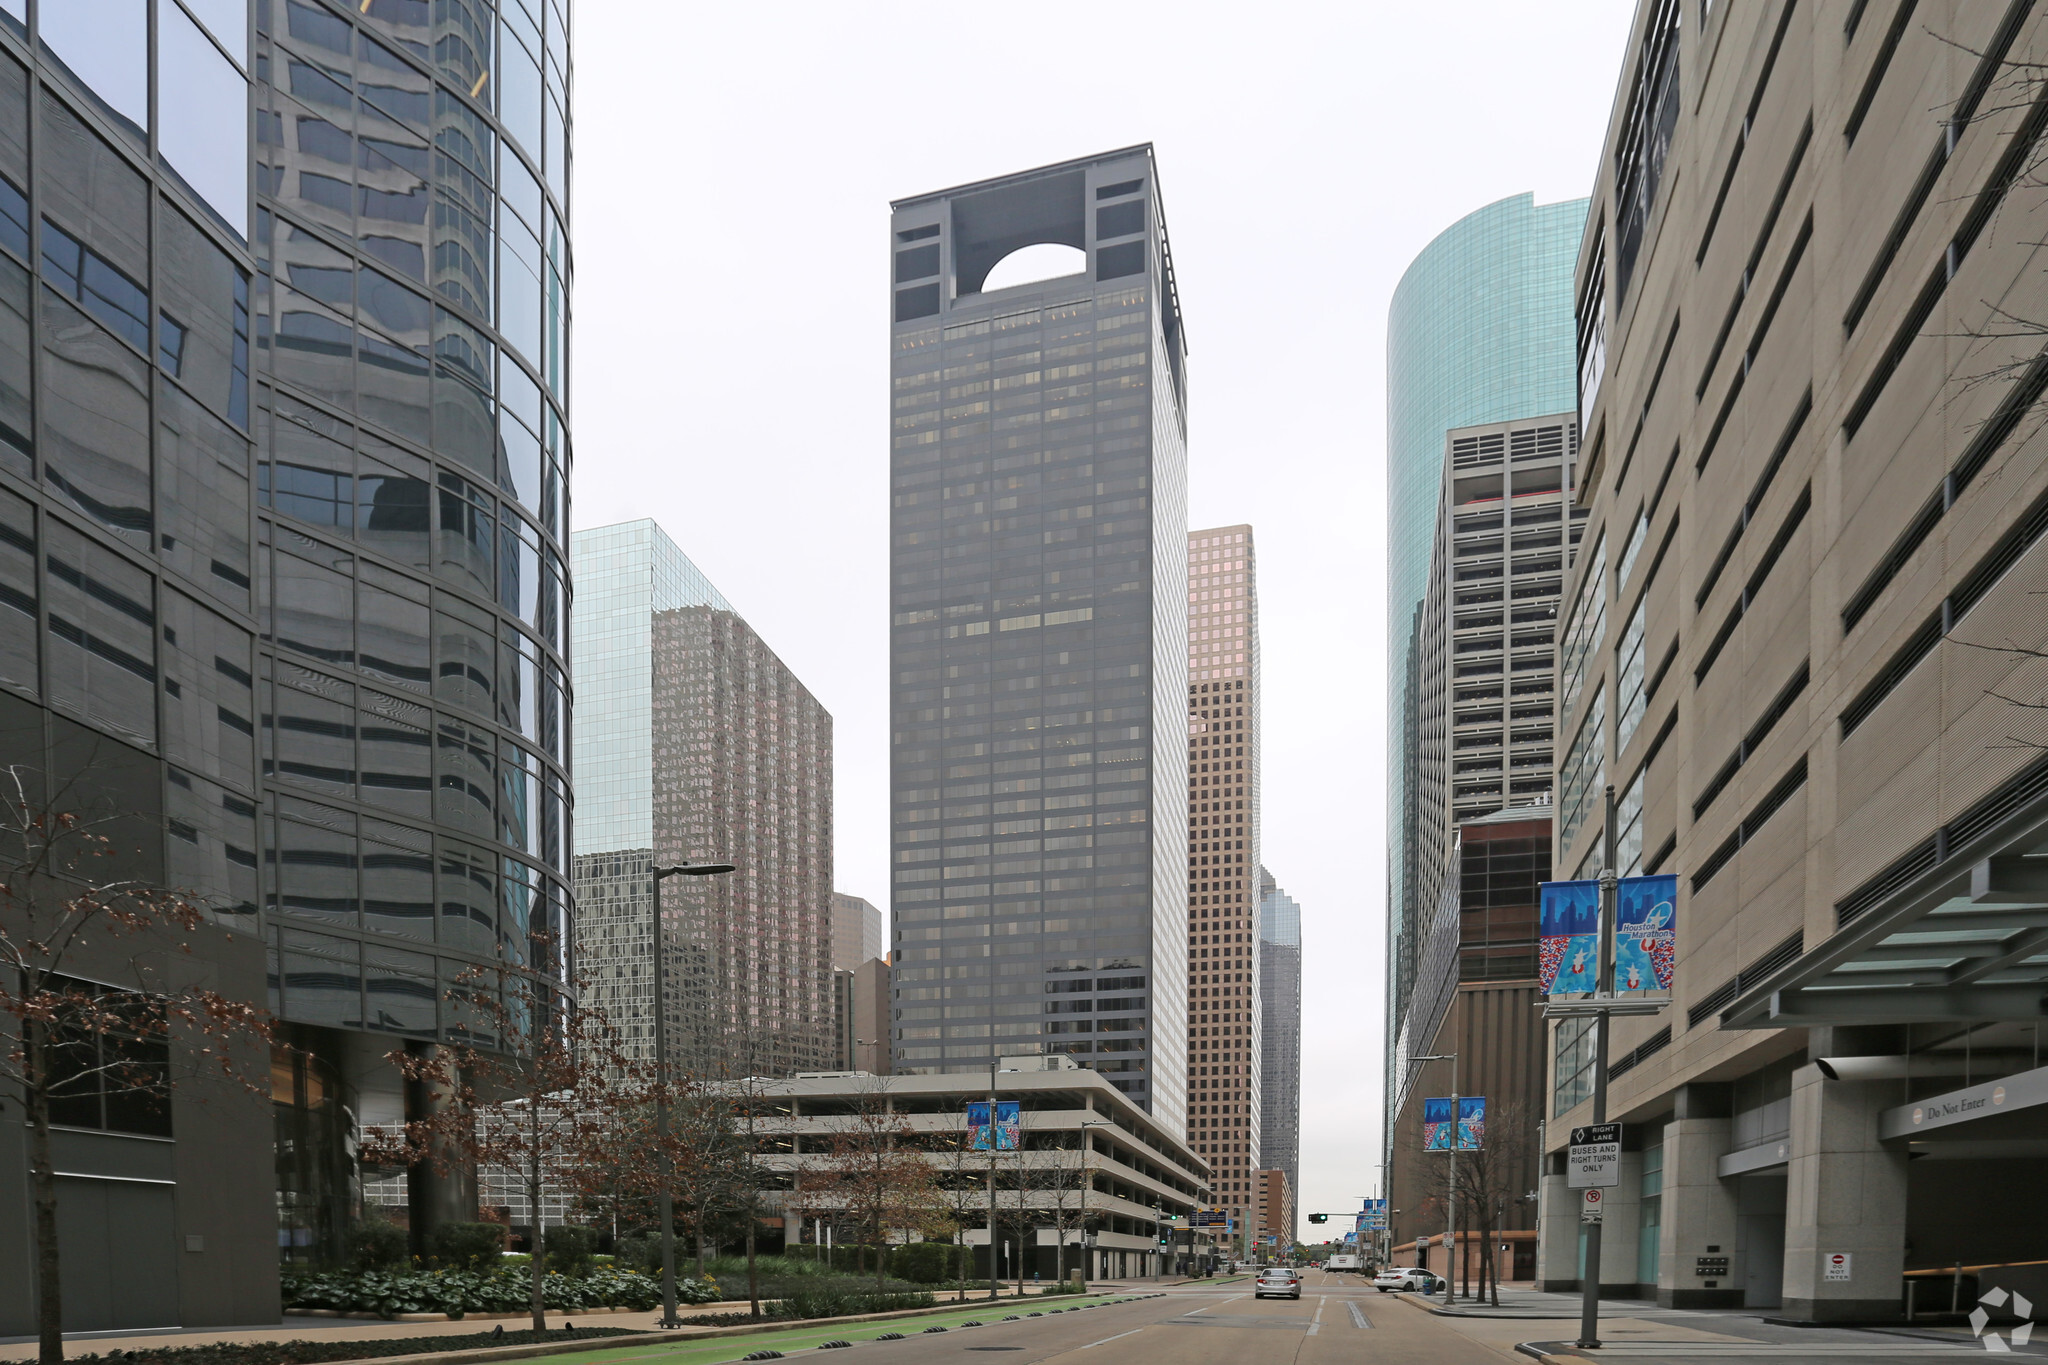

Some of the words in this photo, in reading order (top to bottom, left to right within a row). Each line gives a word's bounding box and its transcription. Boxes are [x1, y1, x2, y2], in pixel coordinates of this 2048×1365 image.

[1623, 924, 1655, 932] Houston
[1632, 931, 1668, 939] Marathon
[1928, 1107, 1940, 1120] Do
[1942, 1103, 1959, 1116] Not
[1961, 1098, 1986, 1112] Enter
[1572, 1146, 1597, 1155] BUSES
[1600, 1145, 1616, 1153] AND
[1571, 1156, 1591, 1164] RIGHT
[1594, 1155, 1616, 1163] TURNS
